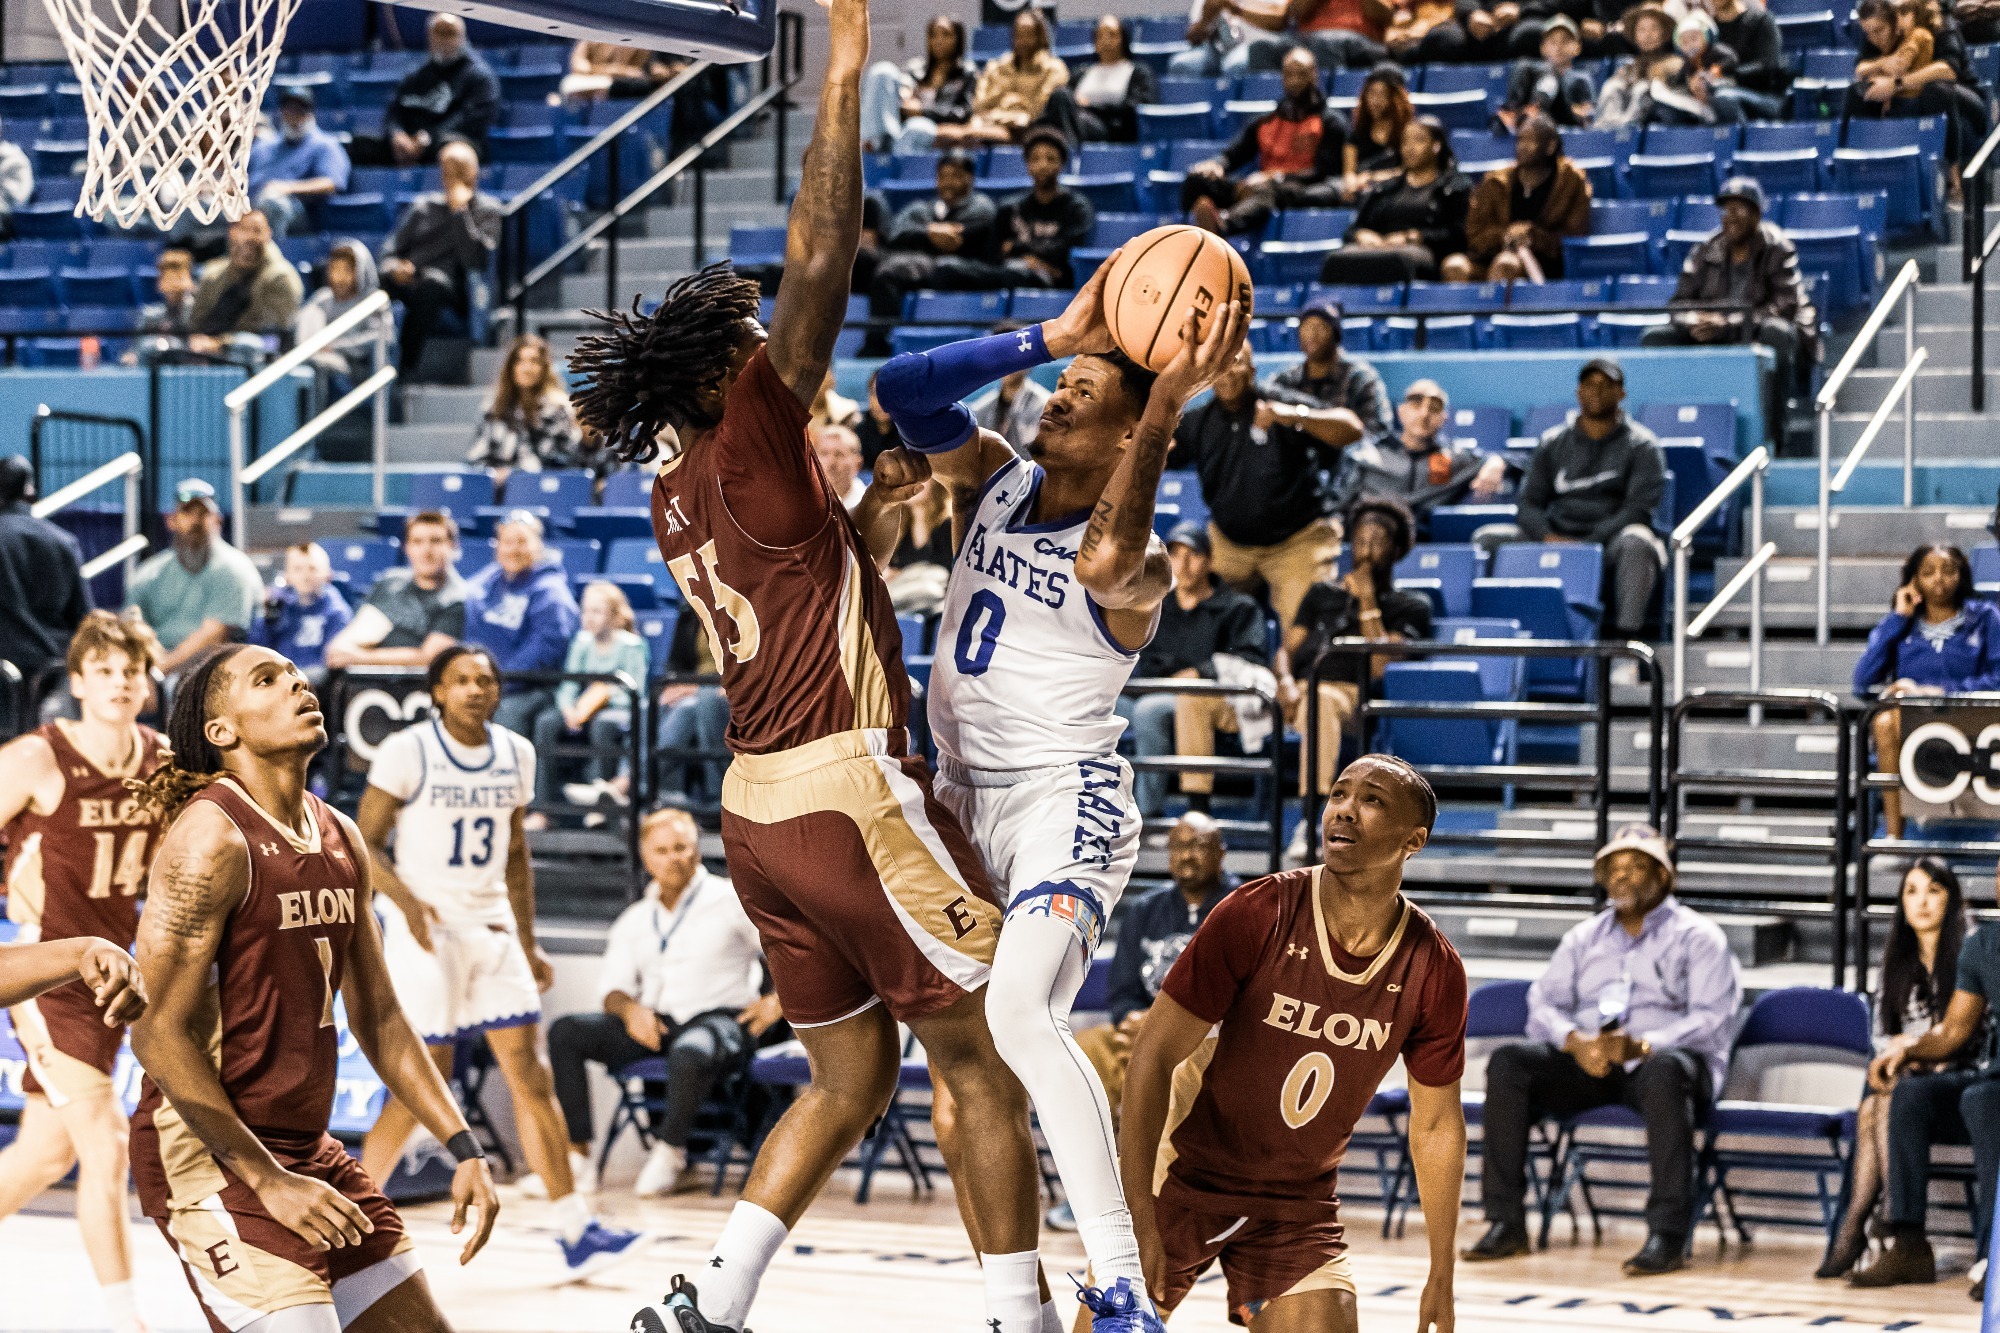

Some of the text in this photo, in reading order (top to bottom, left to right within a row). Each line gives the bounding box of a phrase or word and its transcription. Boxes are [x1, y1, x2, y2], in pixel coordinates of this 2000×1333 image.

[954, 587, 1007, 678] 0
[430, 785, 517, 809] PIRATES
[86, 830, 148, 899] 14
[447, 816, 496, 868] 13
[276, 887, 355, 930] ELON
[941, 894, 979, 943] E
[1262, 992, 1393, 1051] ELON
[1280, 1051, 1335, 1130] 0
[204, 1238, 240, 1280] E
